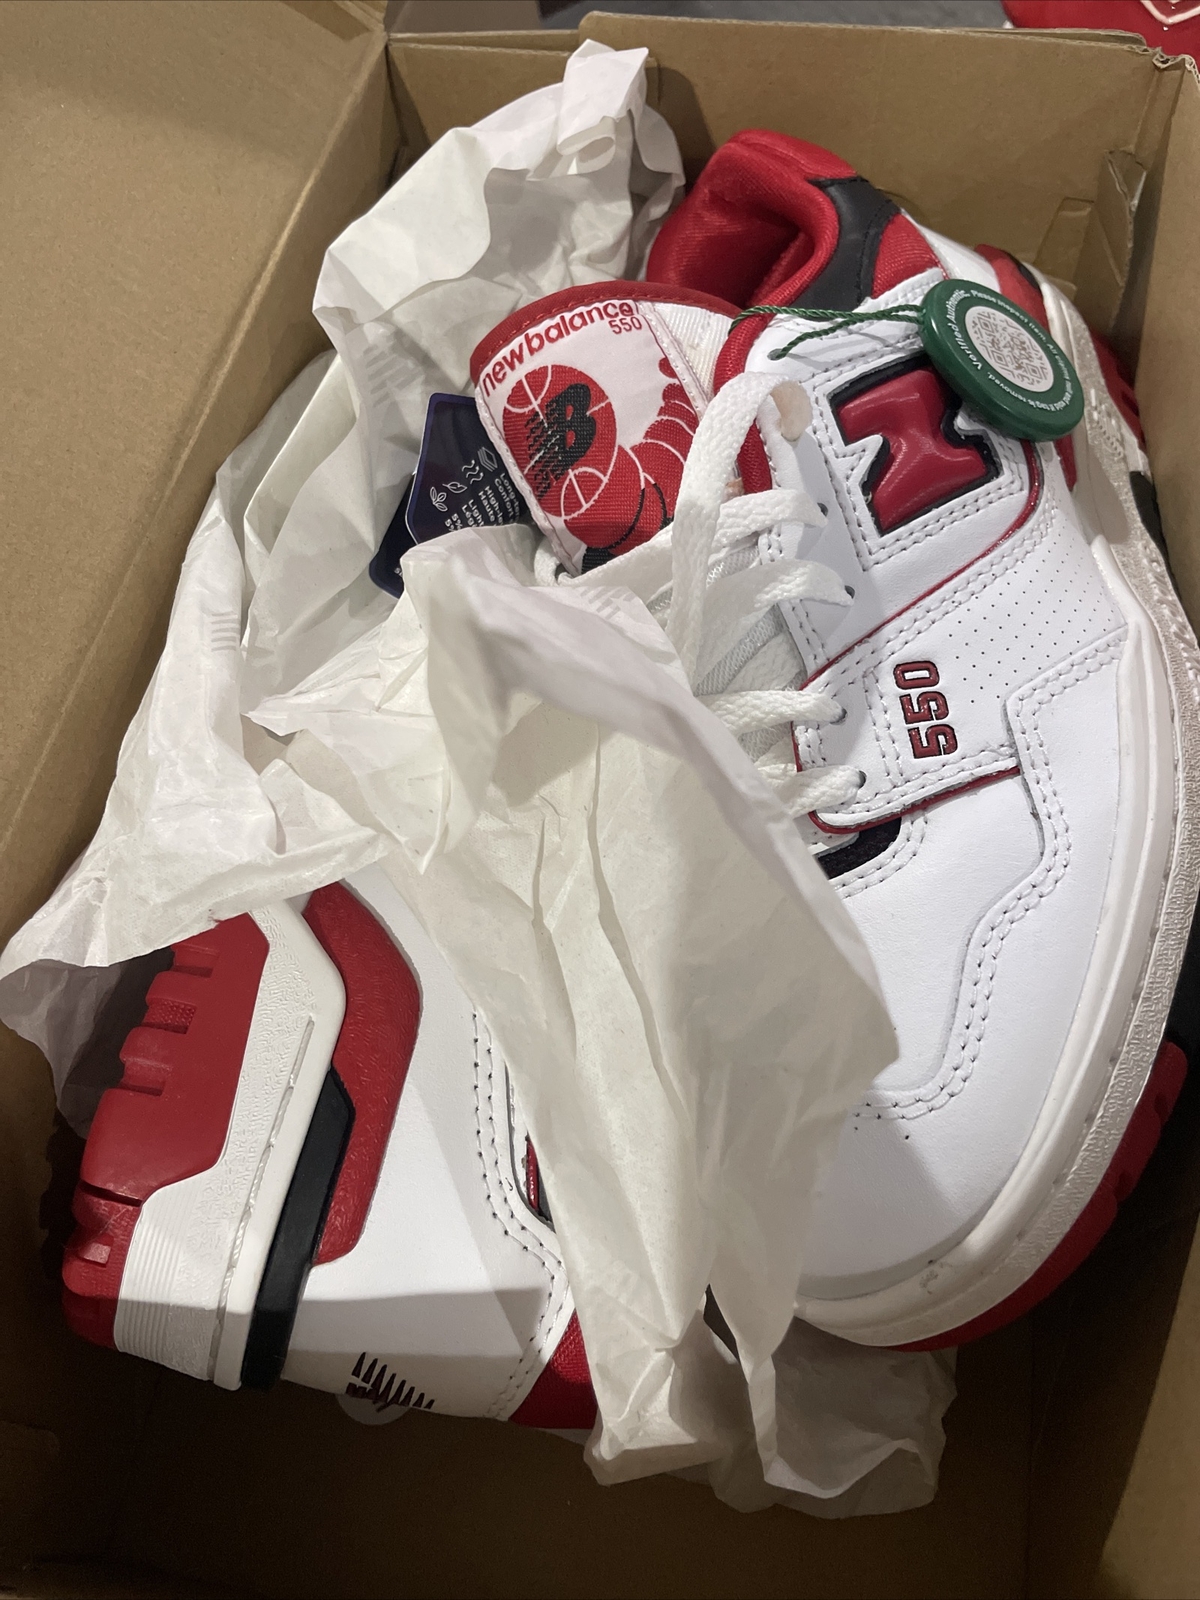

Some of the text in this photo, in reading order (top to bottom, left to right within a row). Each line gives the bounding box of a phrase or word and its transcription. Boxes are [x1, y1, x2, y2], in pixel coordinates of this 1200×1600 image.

[946, 289, 971, 324] Authentic.
[996, 299, 1028, 323] inspect
[608, 317, 642, 335] 550
[947, 322, 982, 370] Verified
[987, 372, 1027, 403] removed.
[478, 491, 495, 522] Haute
[494, 479, 514, 518] Confort
[500, 472, 519, 522] Long-ter
[452, 514, 463, 530] 5%
[893, 660, 958, 760] 550
